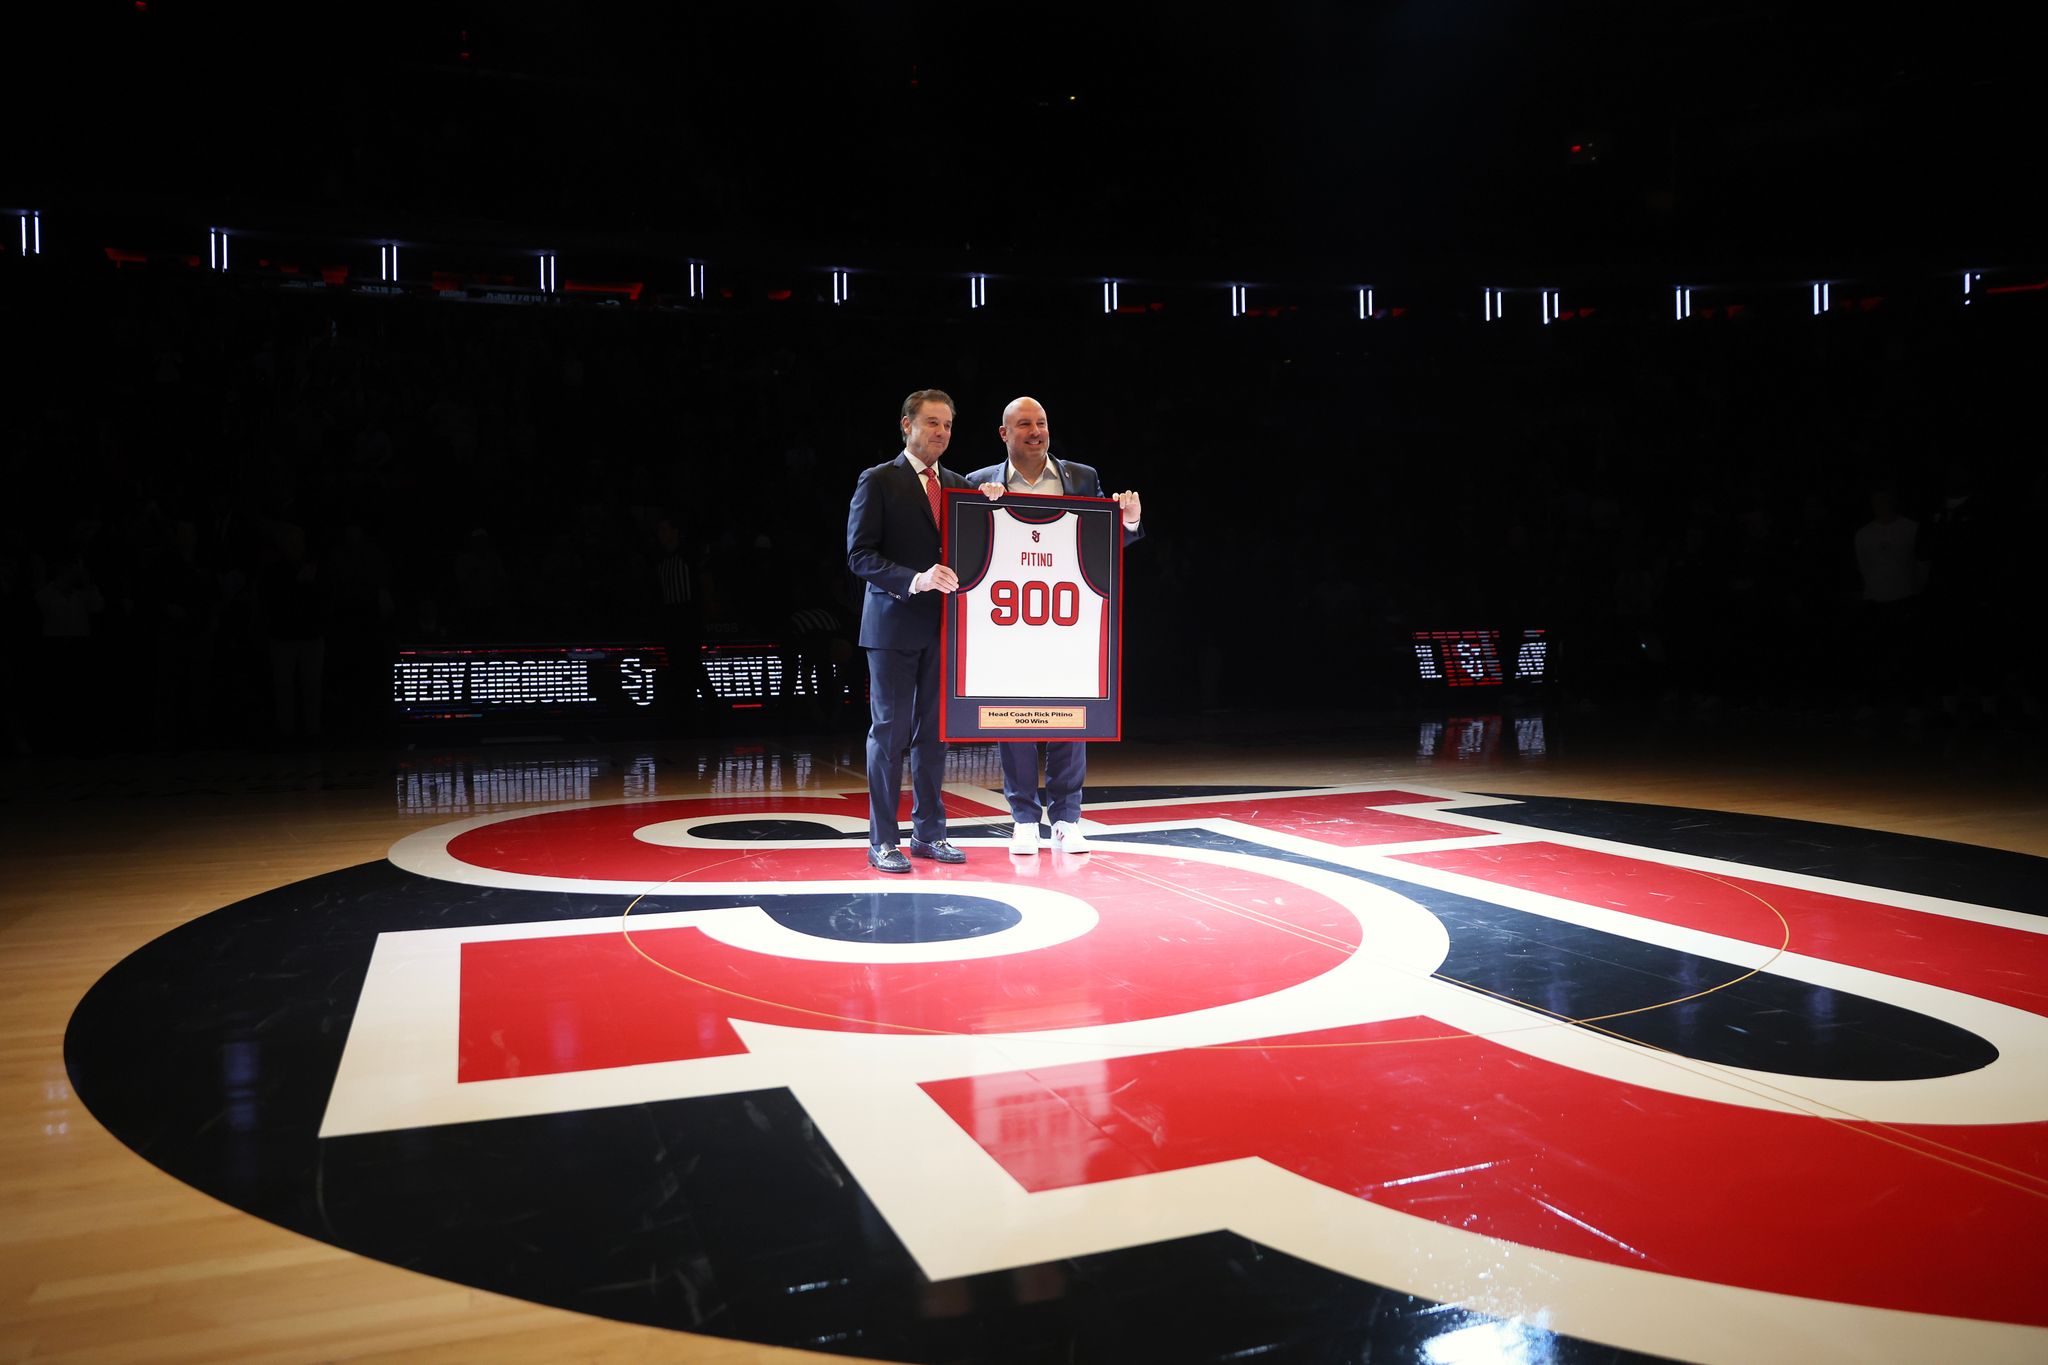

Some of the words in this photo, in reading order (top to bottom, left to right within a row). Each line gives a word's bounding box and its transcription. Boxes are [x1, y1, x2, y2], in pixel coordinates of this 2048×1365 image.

[1021, 551, 1053, 567] PITINO
[990, 580, 1080, 626] 900
[394, 662, 466, 702] EVERY
[699, 656, 764, 698] VERY
